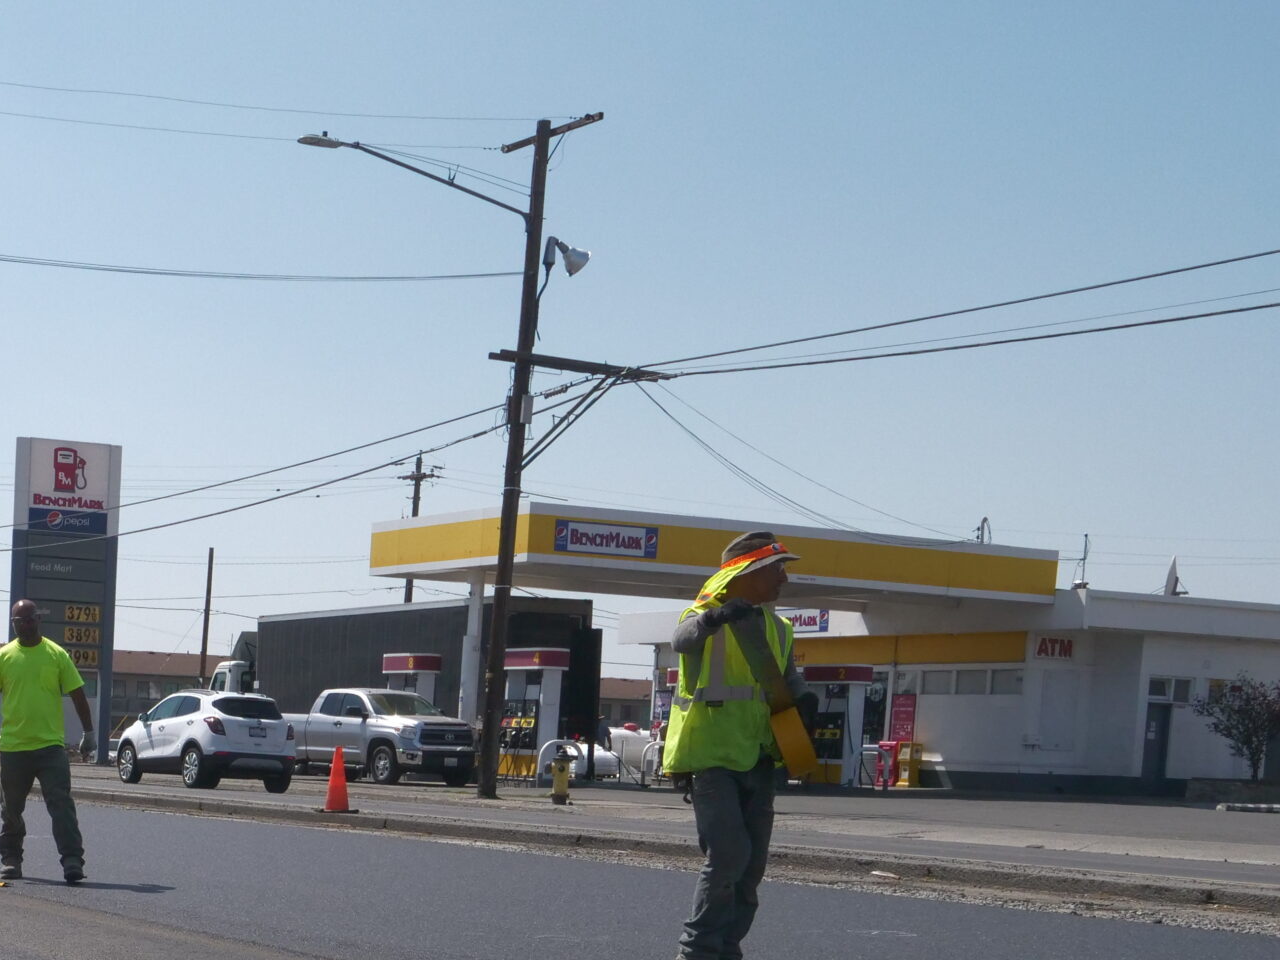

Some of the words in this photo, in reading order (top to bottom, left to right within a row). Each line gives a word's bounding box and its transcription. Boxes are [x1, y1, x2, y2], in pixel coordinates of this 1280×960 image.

[64, 516, 90, 527] pepsi
[31, 562, 51, 572] Food
[53, 563, 73, 573] Mart
[1037, 637, 1072, 658] ATM
[408, 656, 414, 669] 8
[532, 651, 540, 664] 4
[837, 668, 846, 680] 2
